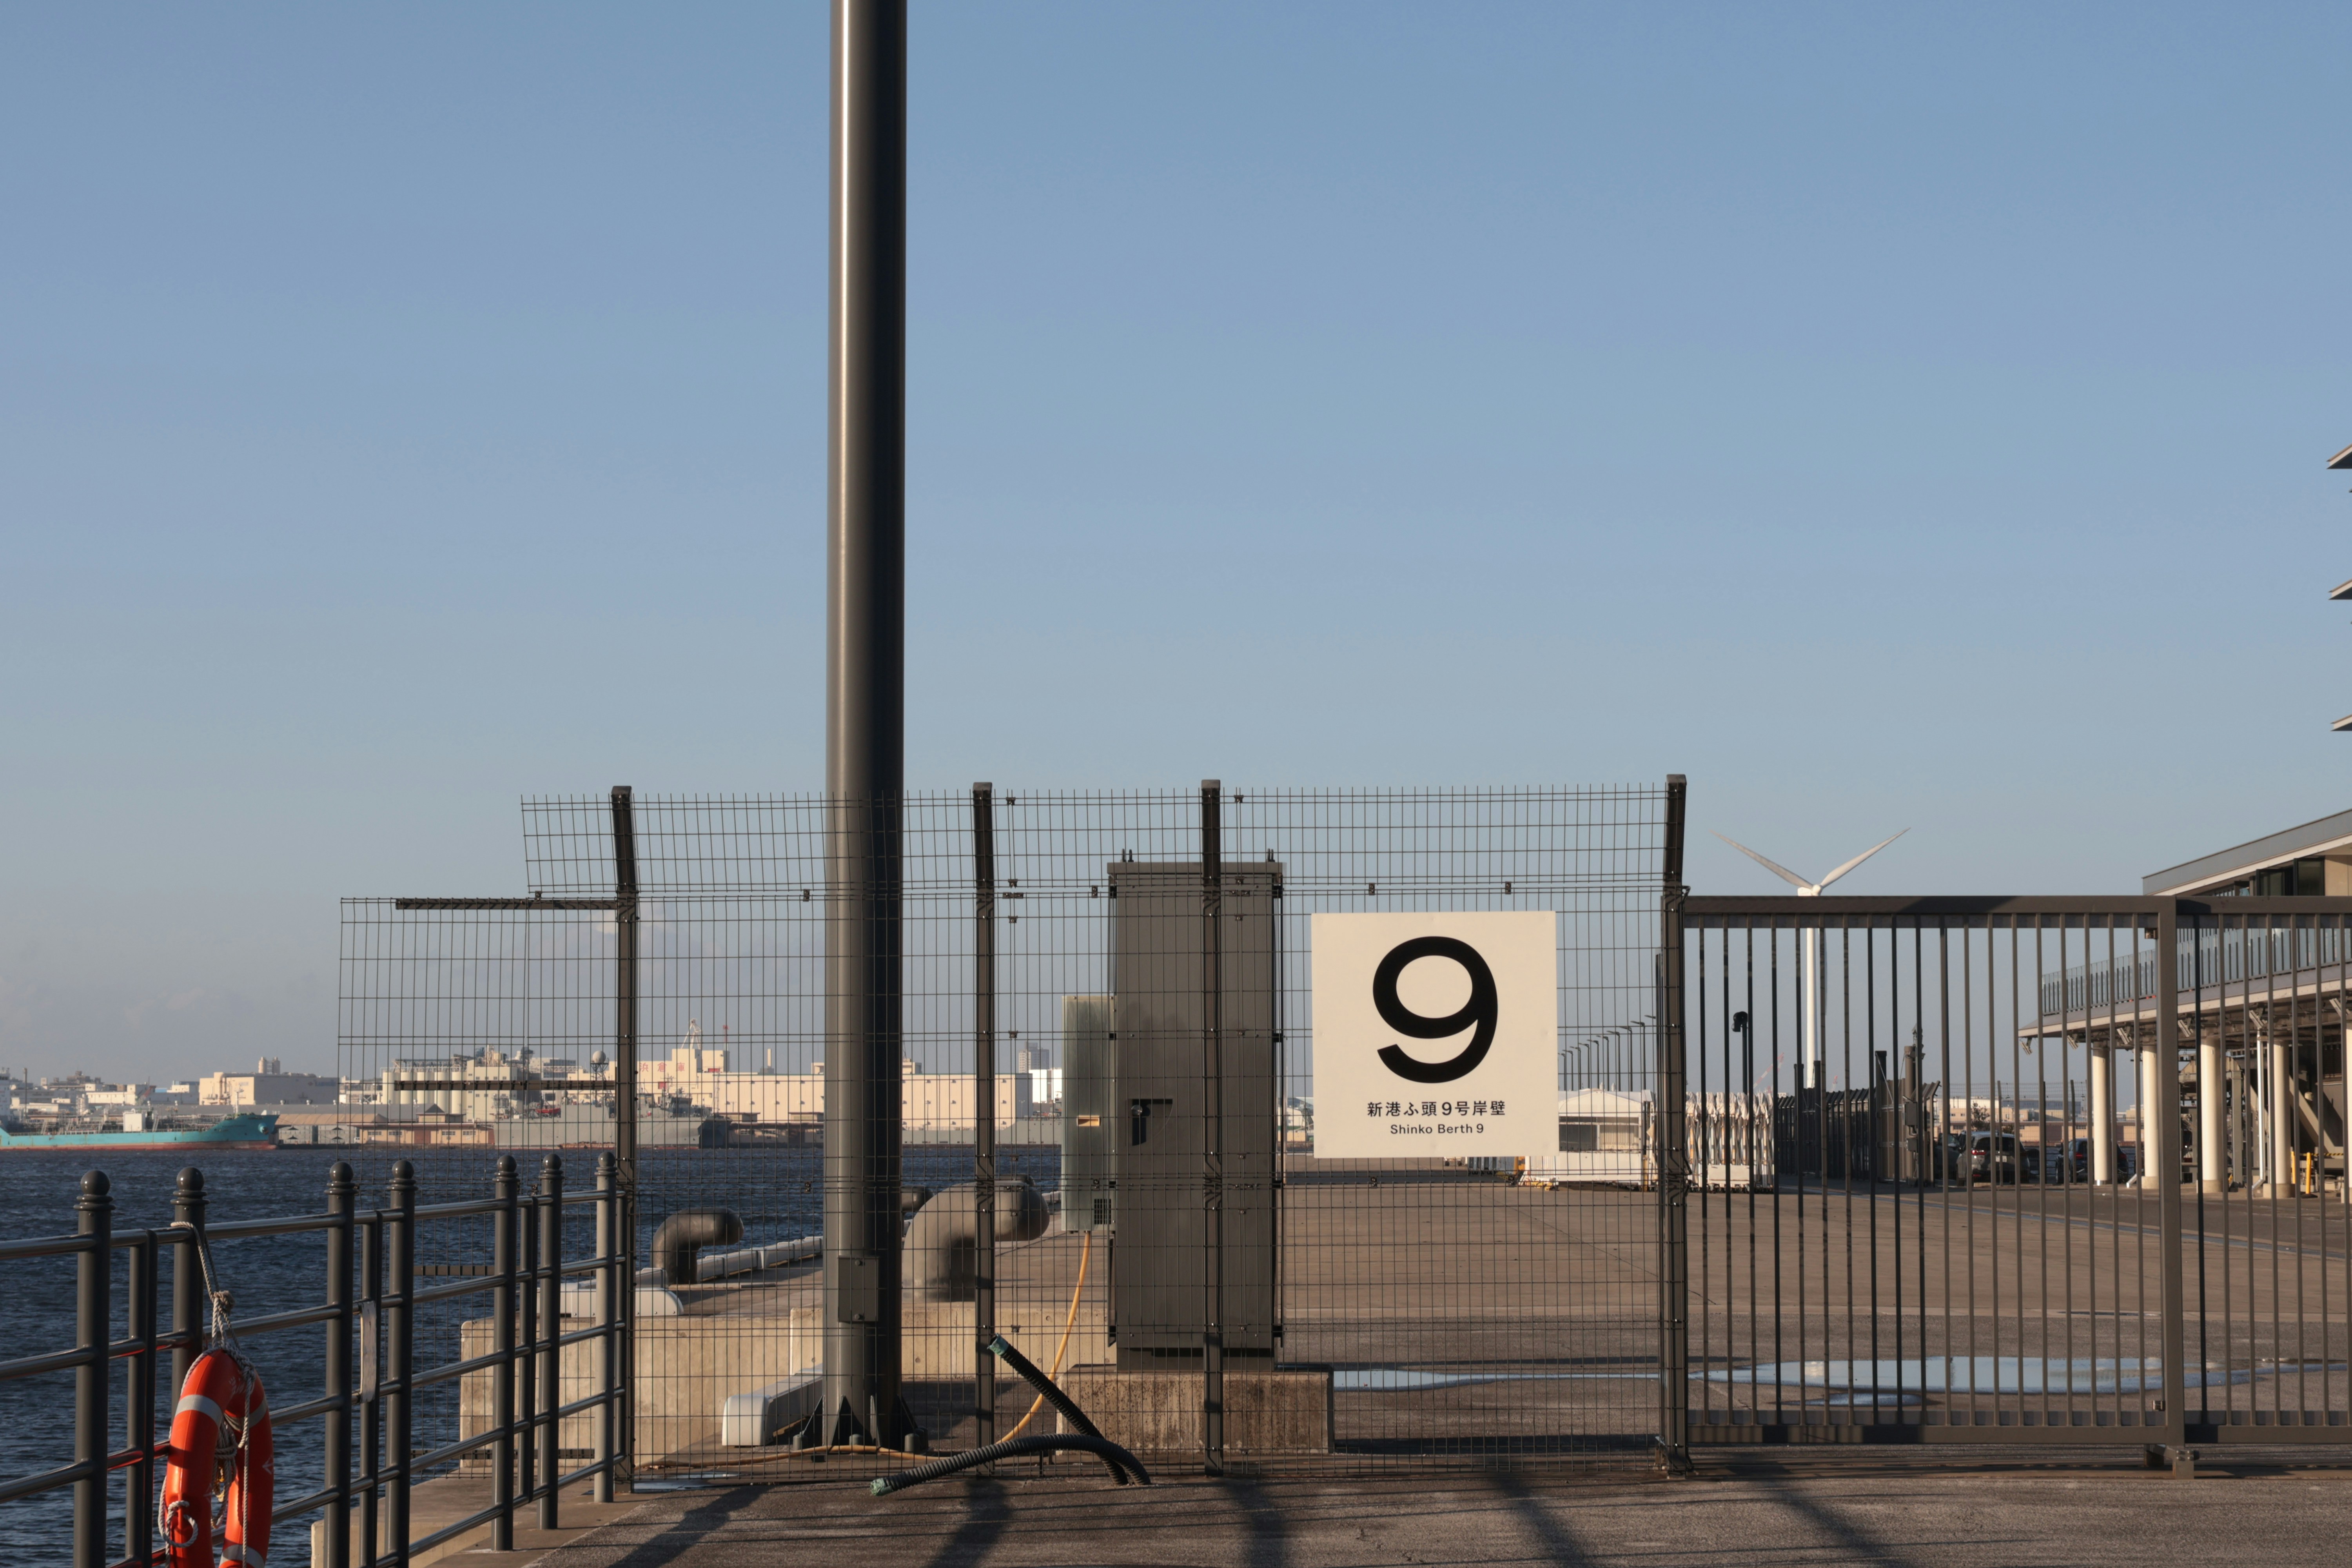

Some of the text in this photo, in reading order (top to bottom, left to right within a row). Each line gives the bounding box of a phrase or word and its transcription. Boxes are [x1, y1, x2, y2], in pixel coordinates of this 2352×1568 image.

[1373, 936, 1498, 1083] 9
[1367, 1100, 1505, 1117] 新港ふ頭9号岸壁
[1390, 1123, 1484, 1134] Shinko Berth 9
